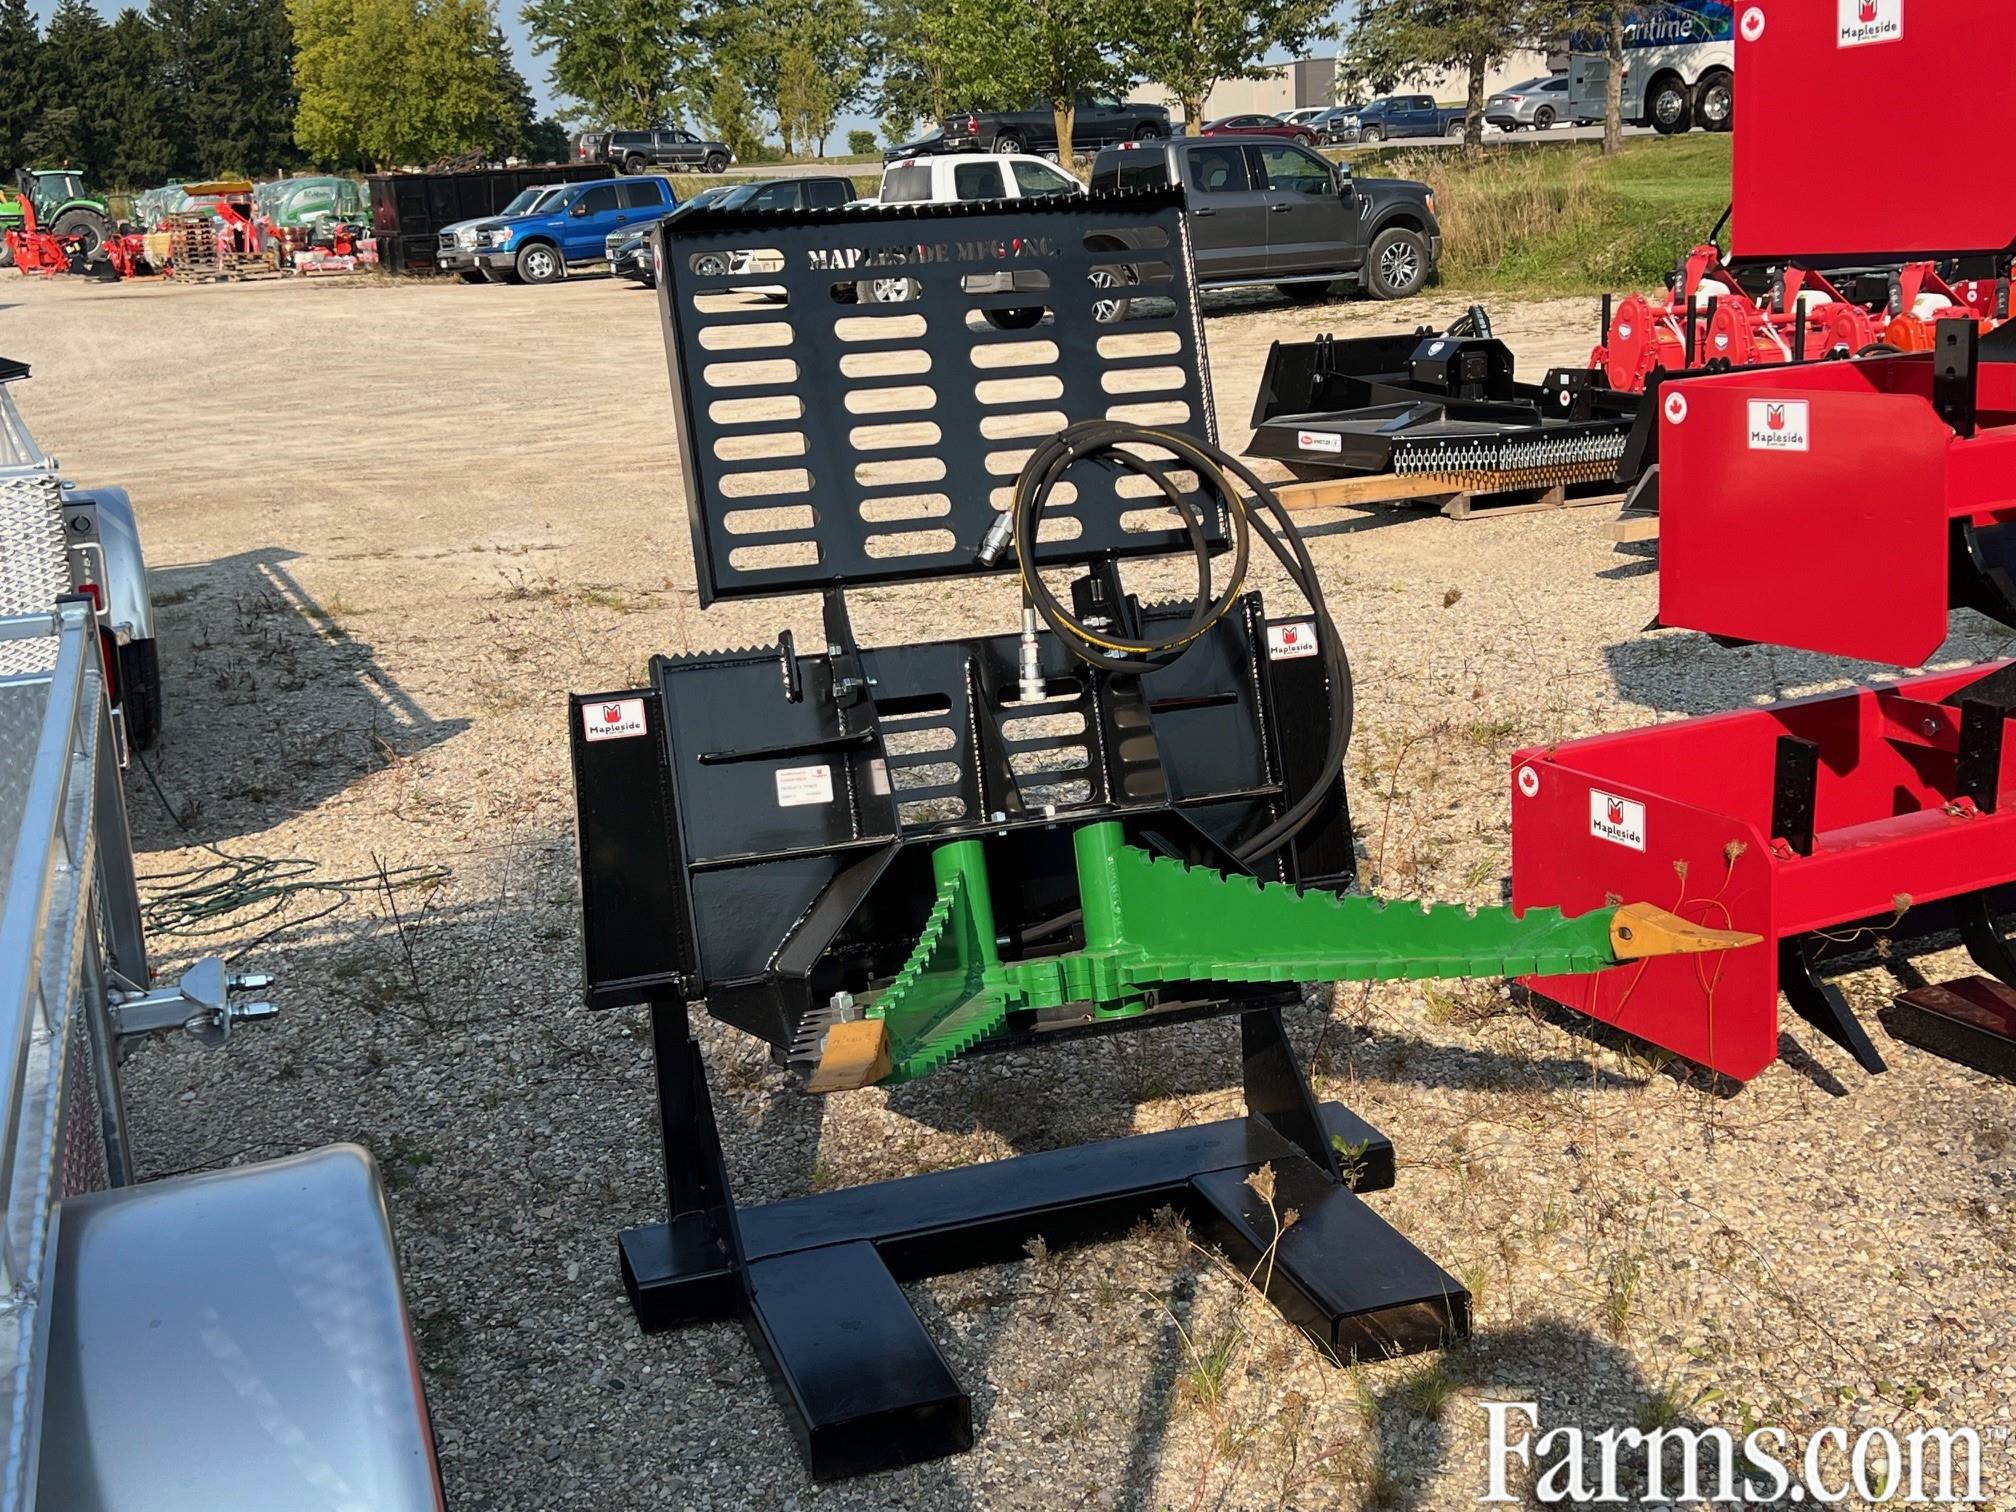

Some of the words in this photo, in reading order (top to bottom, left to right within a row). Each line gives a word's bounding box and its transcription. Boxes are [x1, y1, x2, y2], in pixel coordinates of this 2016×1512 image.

[1841, 19, 1897, 41] Mapleside
[808, 242, 950, 270] MAPLESIDE
[1751, 431, 1804, 447] Mapleside
[589, 721, 641, 736] Mapleside
[1593, 818, 1641, 843] Mapleside
